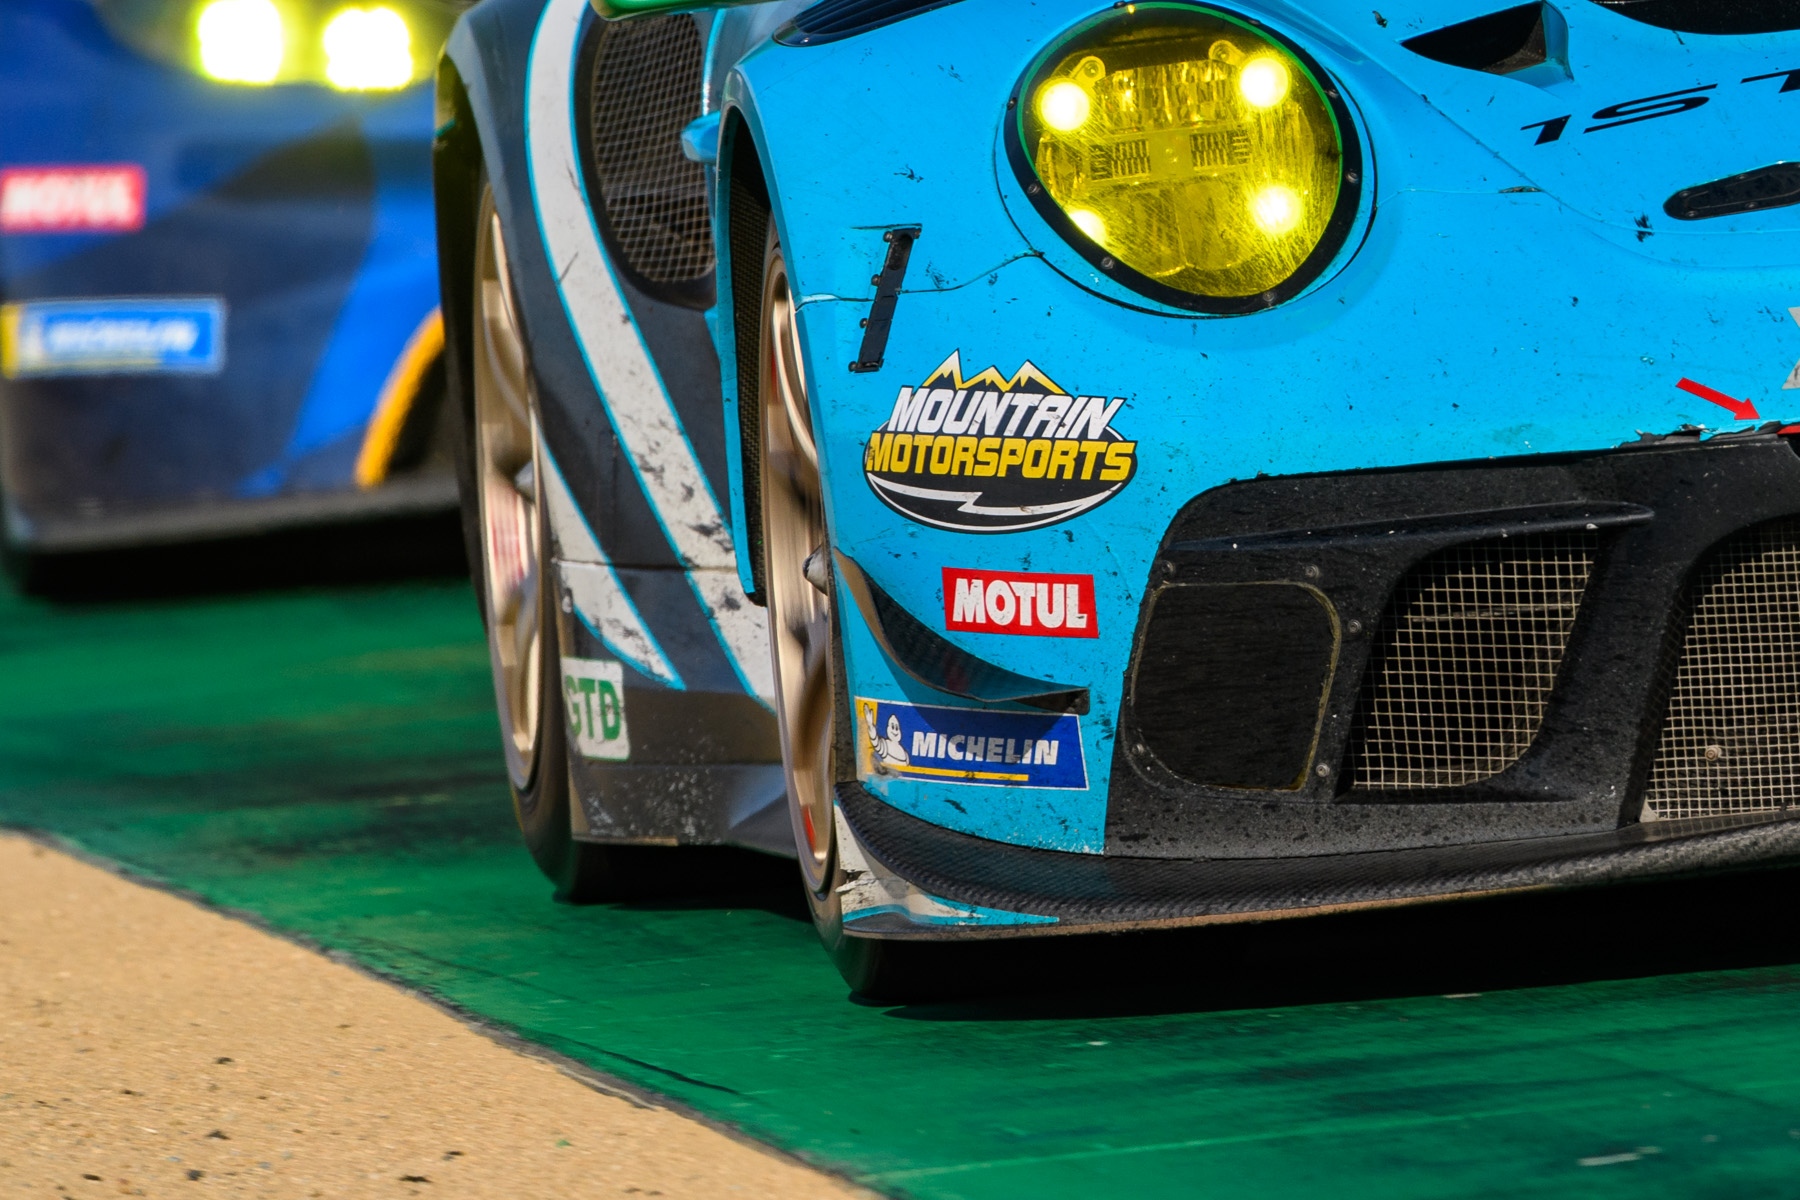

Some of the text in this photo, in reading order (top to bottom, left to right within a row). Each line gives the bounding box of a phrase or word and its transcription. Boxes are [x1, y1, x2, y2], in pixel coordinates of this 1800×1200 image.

[886, 386, 1126, 441] MOUNTAIN
[865, 431, 1137, 482] MOTORSPORTS
[951, 577, 1089, 630] MOTUL
[911, 730, 1060, 767] MICHELIN
